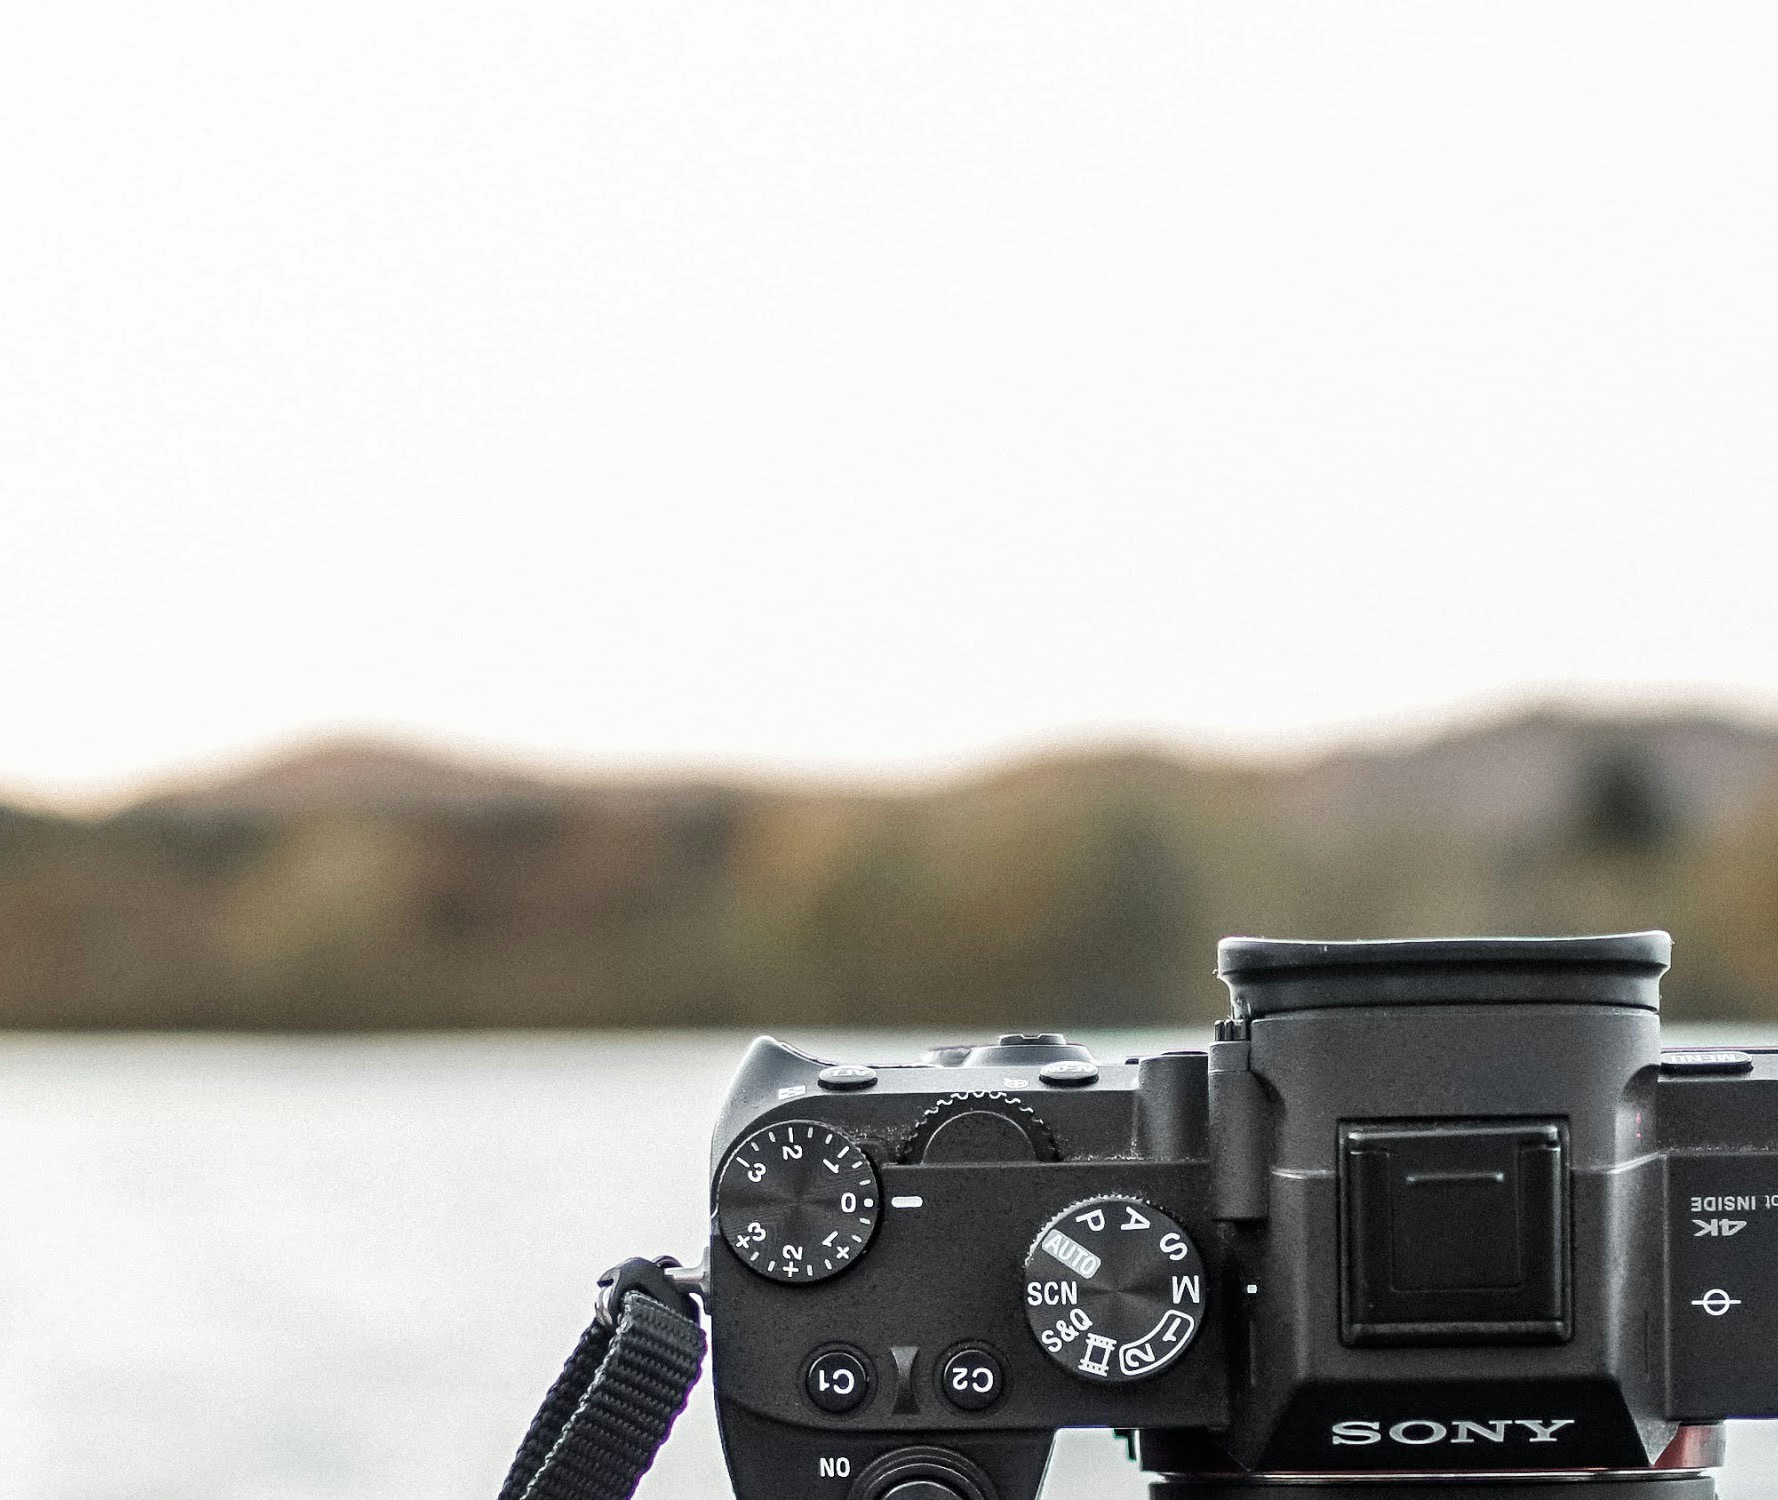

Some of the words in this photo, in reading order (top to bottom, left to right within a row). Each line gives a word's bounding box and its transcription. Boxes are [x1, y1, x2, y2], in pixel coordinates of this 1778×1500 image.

[840, 1192, 857, 1213] 0
[1690, 1195, 1756, 1212] INSIDE
[1075, 1208, 1106, 1232] P
[1120, 1206, 1151, 1231] A
[1691, 1218, 1748, 1237] 4K
[735, 1222, 767, 1249] +3
[821, 1230, 850, 1260] +1
[1159, 1232, 1188, 1261] S
[782, 1244, 803, 1278] +2
[1043, 1232, 1099, 1277] AUTO
[1026, 1280, 1078, 1306] SCN
[1171, 1274, 1200, 1305] M
[1041, 1308, 1094, 1353] S&Q
[1162, 1317, 1182, 1343] 1
[1124, 1342, 1156, 1368] 2
[818, 1368, 855, 1395] C1
[952, 1366, 994, 1393] C2
[1331, 1417, 1576, 1446] SONY
[819, 1456, 851, 1478] ON
